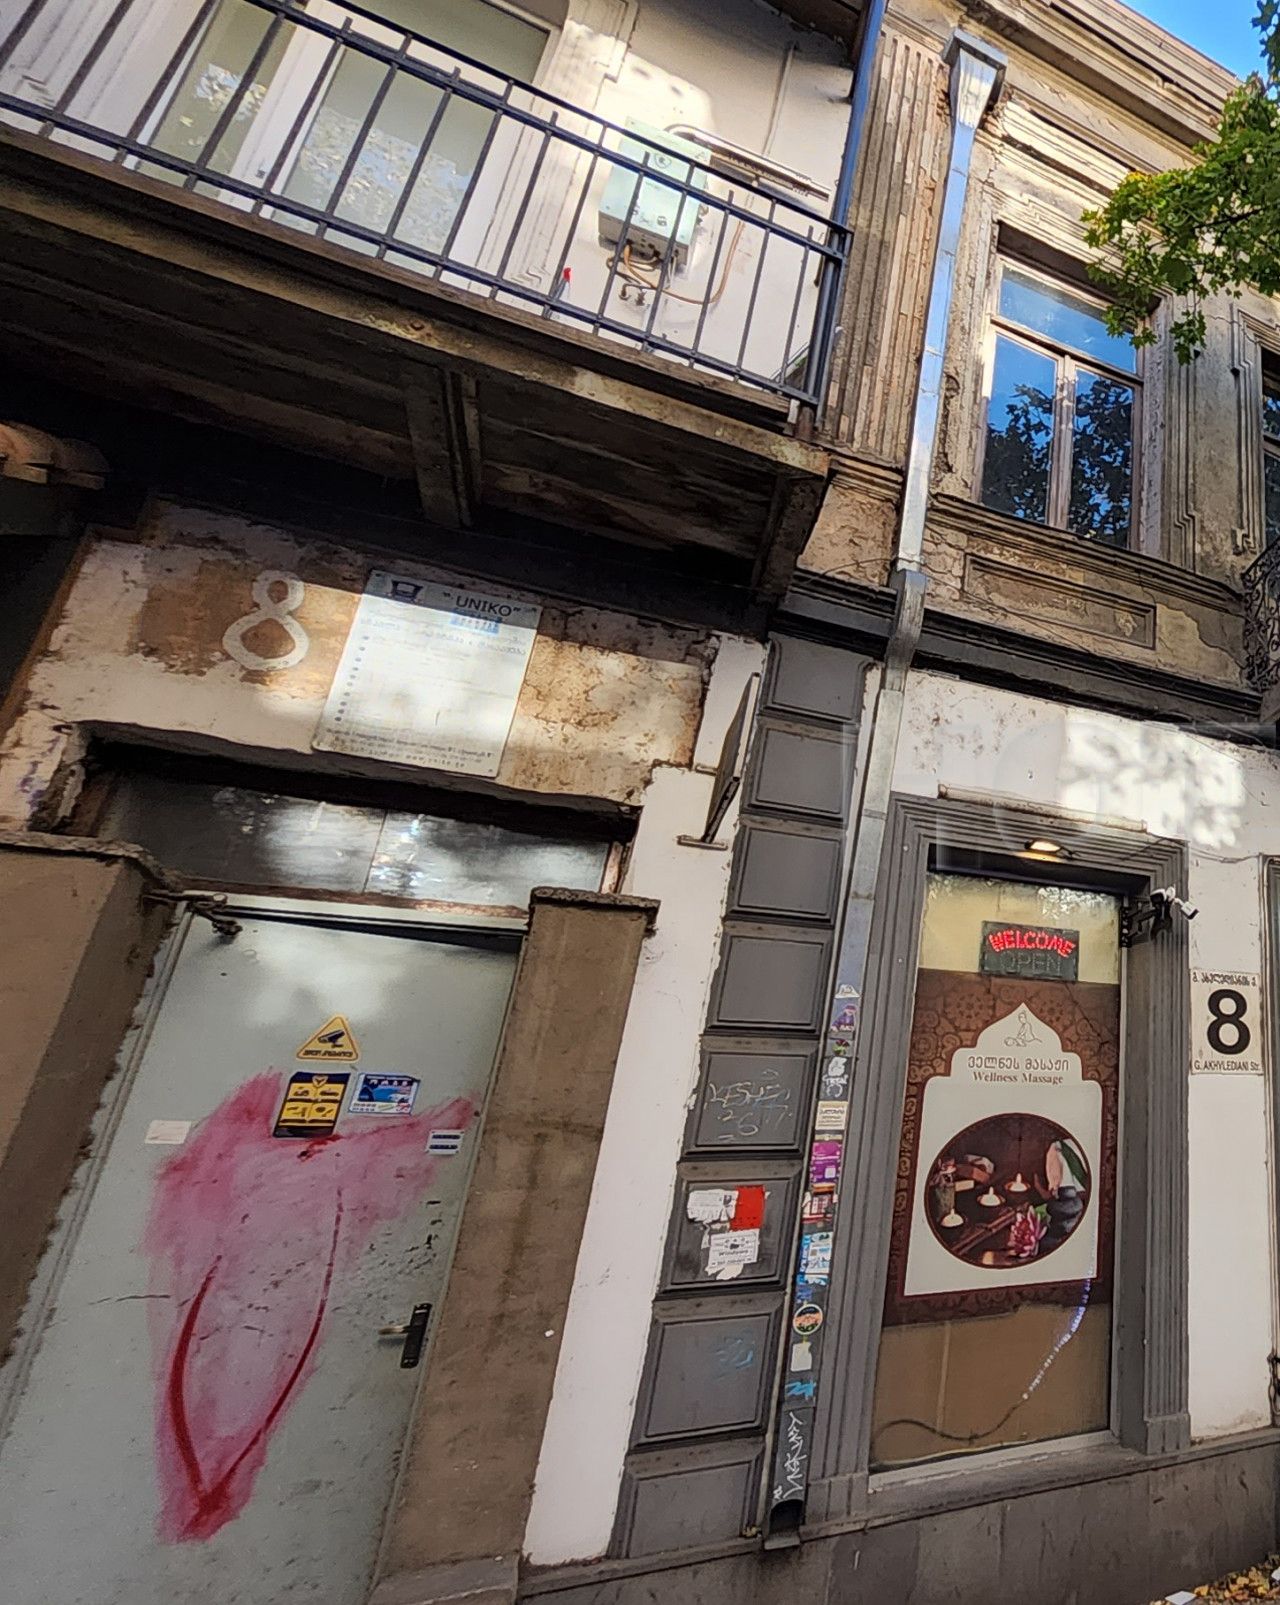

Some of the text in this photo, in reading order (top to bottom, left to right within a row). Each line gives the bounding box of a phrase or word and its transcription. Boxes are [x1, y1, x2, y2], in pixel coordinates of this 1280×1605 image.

[222, 570, 309, 672] 8
[988, 929, 1076, 957] WELCOME
[1000, 951, 1061, 975] OPEN
[1207, 988, 1251, 1055] 8
[968, 1056, 1069, 1072] ველნეს მასაჟი
[1194, 1060, 1201, 1071] G.
[973, 1071, 1064, 1085] Wellness Massage
